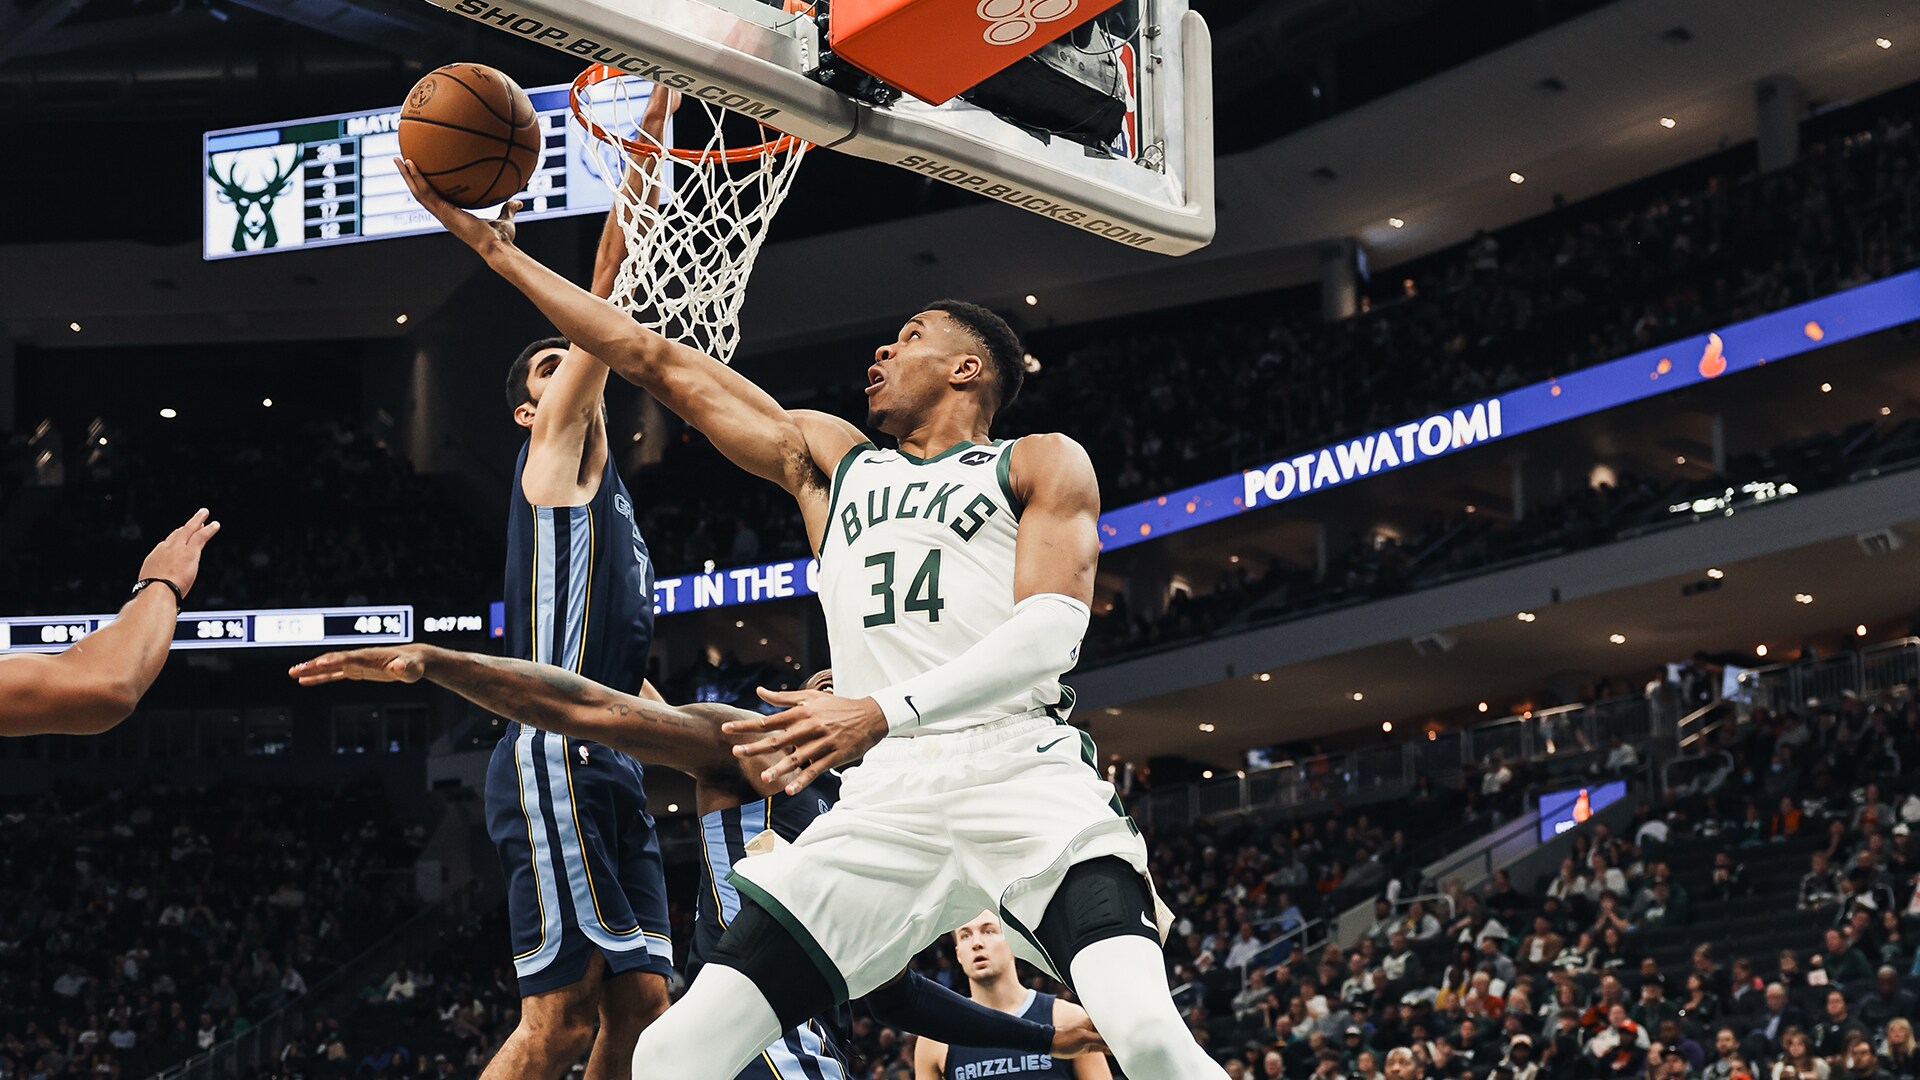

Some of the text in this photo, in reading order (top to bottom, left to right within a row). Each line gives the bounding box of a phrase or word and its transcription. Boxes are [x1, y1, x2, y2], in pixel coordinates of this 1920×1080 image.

[454, 0, 782, 120] SHOP.BUCKS.COM
[896, 154, 1155, 247] SHOP.BUCKS.COM
[1242, 397, 1502, 508] POTAWATOMI
[840, 481, 999, 546] BUCKS
[693, 572, 724, 608] IN
[730, 562, 795, 603] THE
[862, 548, 946, 629] 34
[954, 1054, 1053, 1080] GRIZZLIES
